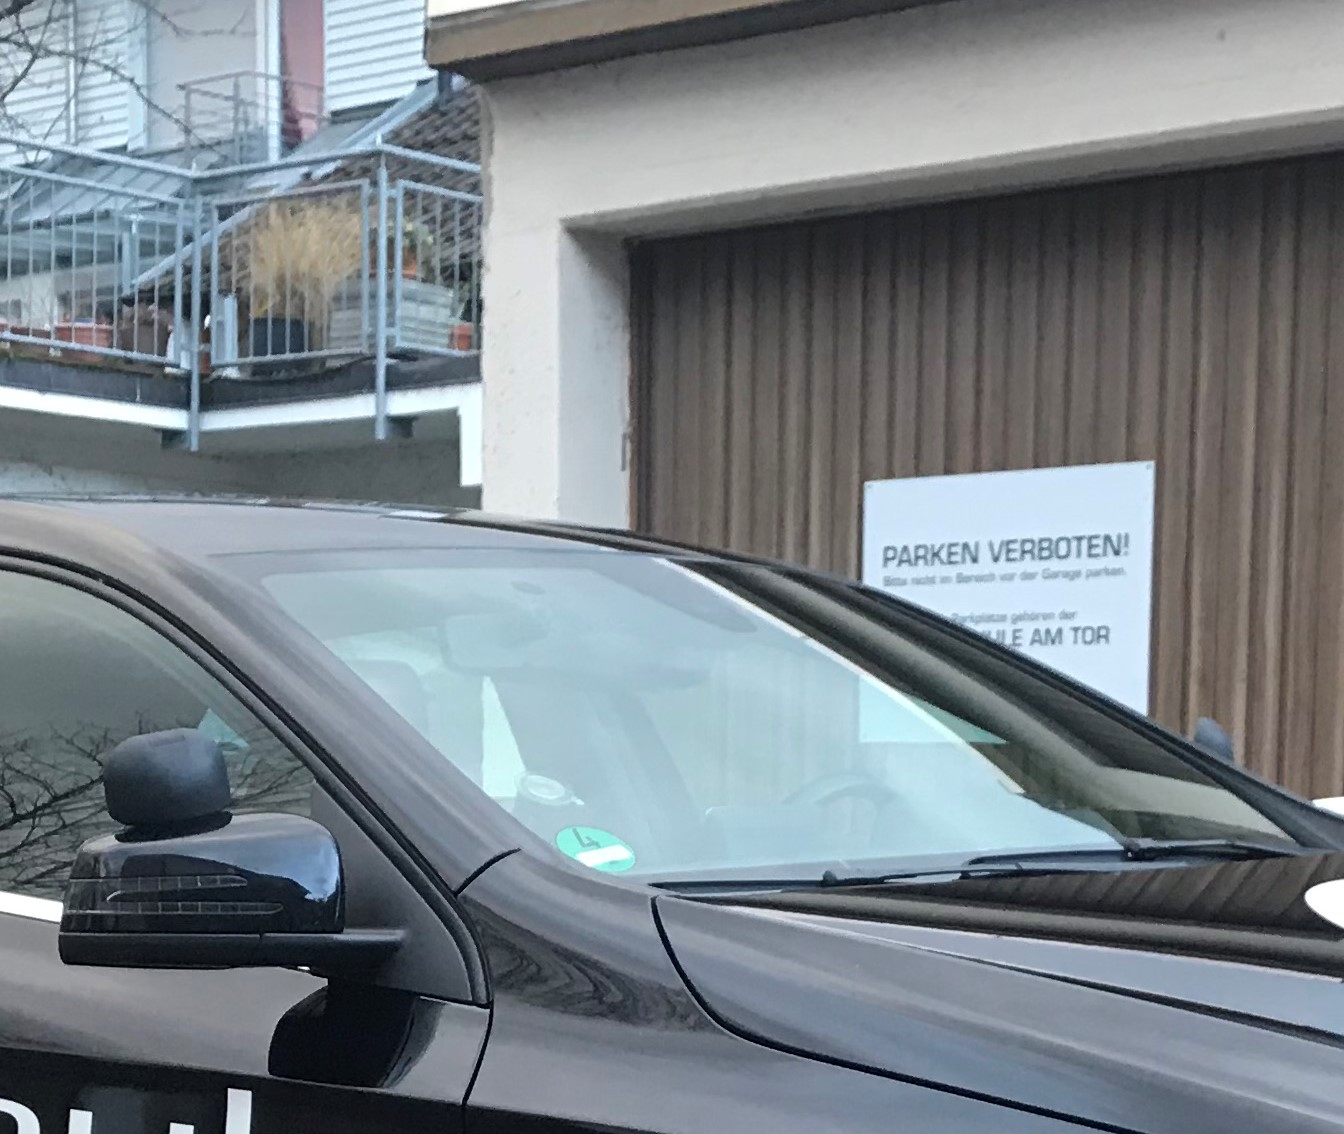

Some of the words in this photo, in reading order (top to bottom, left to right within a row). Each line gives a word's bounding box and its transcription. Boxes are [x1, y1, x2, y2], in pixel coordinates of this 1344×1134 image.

[881, 541, 980, 568] PARKEN
[987, 532, 1130, 563] VERBOTEN!
[1041, 567, 1082, 582] Garage
[1029, 625, 1064, 646] AM
[1069, 624, 1111, 646] TOR
